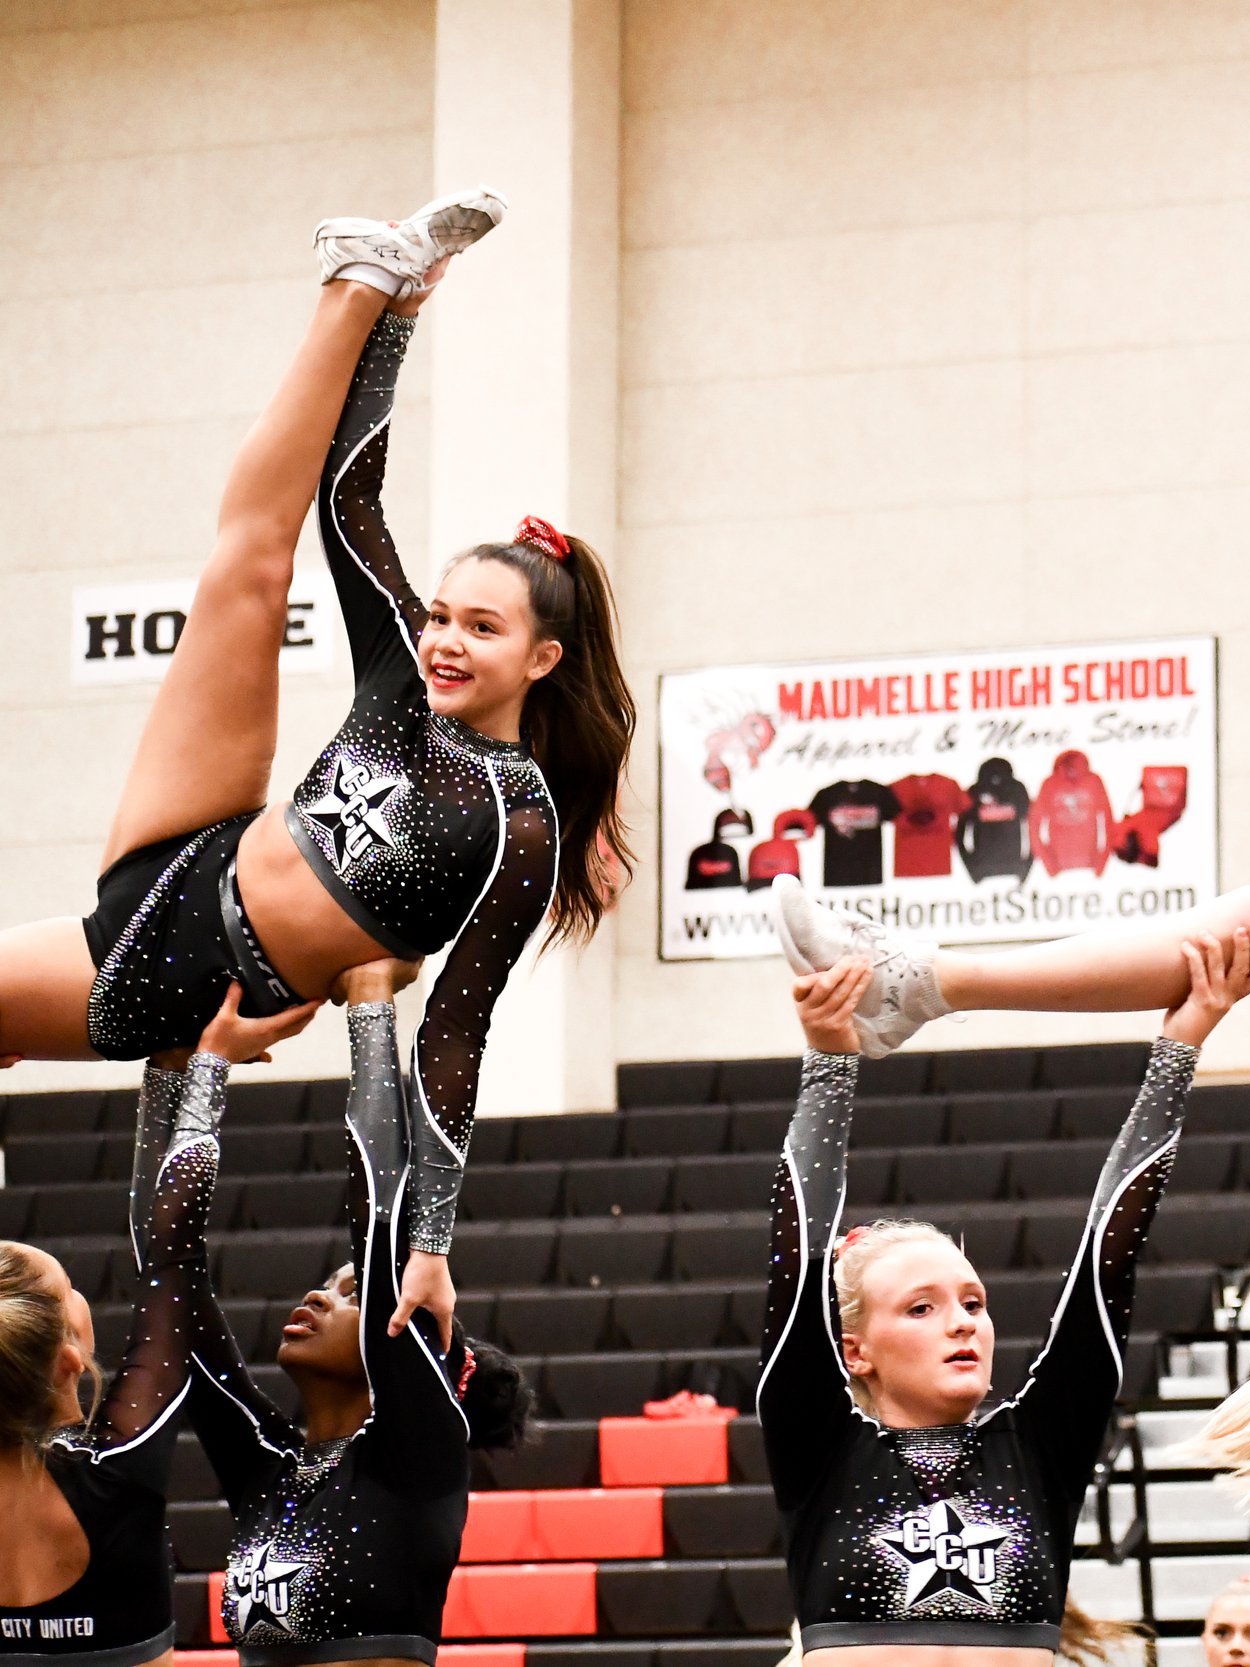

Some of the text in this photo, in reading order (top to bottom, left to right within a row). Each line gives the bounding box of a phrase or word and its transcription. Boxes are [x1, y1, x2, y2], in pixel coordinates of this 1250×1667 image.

[86, 603, 313, 659] HOE
[778, 657, 1195, 721] MAUMELLE HIGH SCHOOL
[780, 708, 1198, 767] Apparel & More Store!
[339, 764, 374, 859] CCU
[902, 1517, 997, 1586] CCU
[237, 1554, 288, 1616] CCU
[1, 1617, 94, 1639] CITY UNITED
